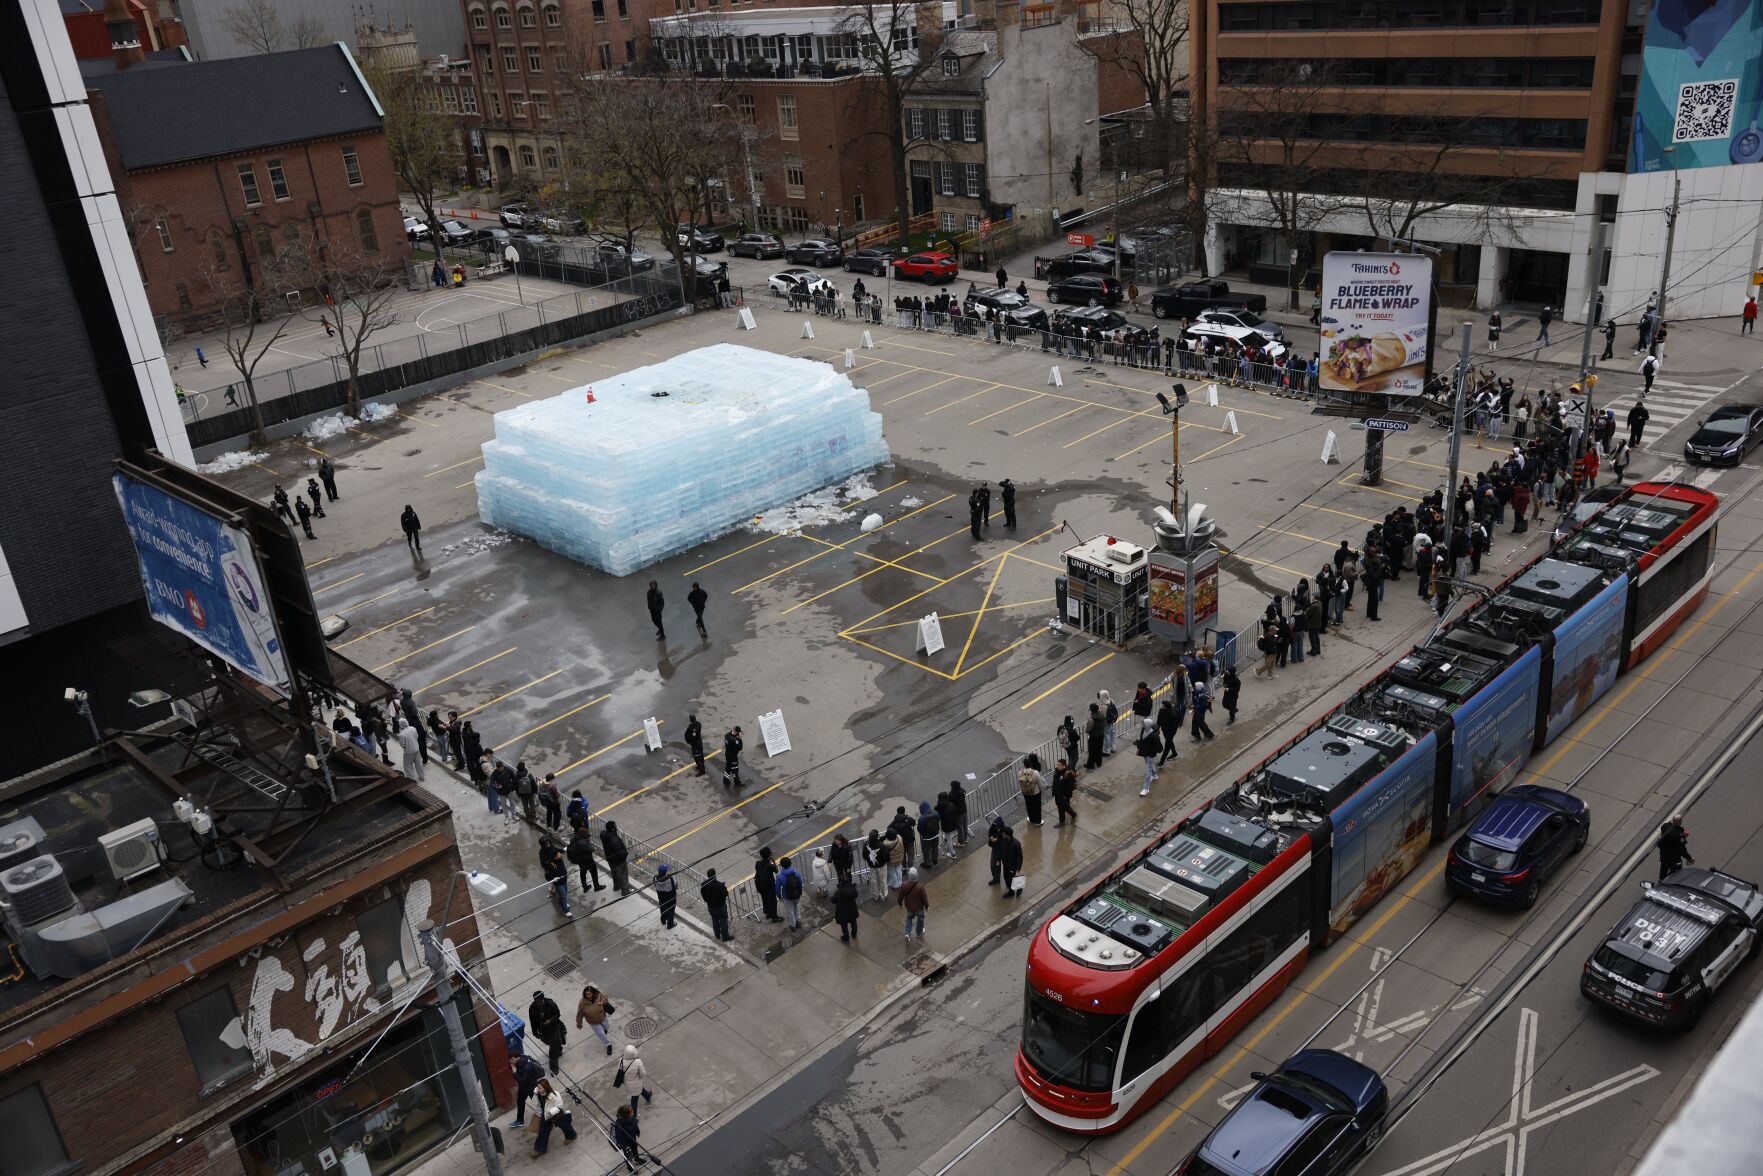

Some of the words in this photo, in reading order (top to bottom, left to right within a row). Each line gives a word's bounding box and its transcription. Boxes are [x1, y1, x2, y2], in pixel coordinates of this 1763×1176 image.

[1351, 263, 1388, 274] TAHINI'S
[1338, 285, 1413, 297] BLUEBERRY
[1330, 298, 1370, 309] FLAME
[1382, 297, 1419, 309] WRAP
[1369, 420, 1407, 430] PATTISON
[131, 499, 195, 552] Award-winning
[195, 536, 214, 562] app
[137, 522, 152, 544] for
[1071, 558, 1089, 570] UNIT
[1089, 564, 1110, 579] PARK
[1132, 568, 1145, 579] UNIT
[153, 577, 185, 608] BMO
[1635, 918, 1686, 943] DUTY
[1608, 971, 1645, 992] POLICE
[1045, 988, 1063, 1002] 4526
[315, 1083, 343, 1100] OPEN
